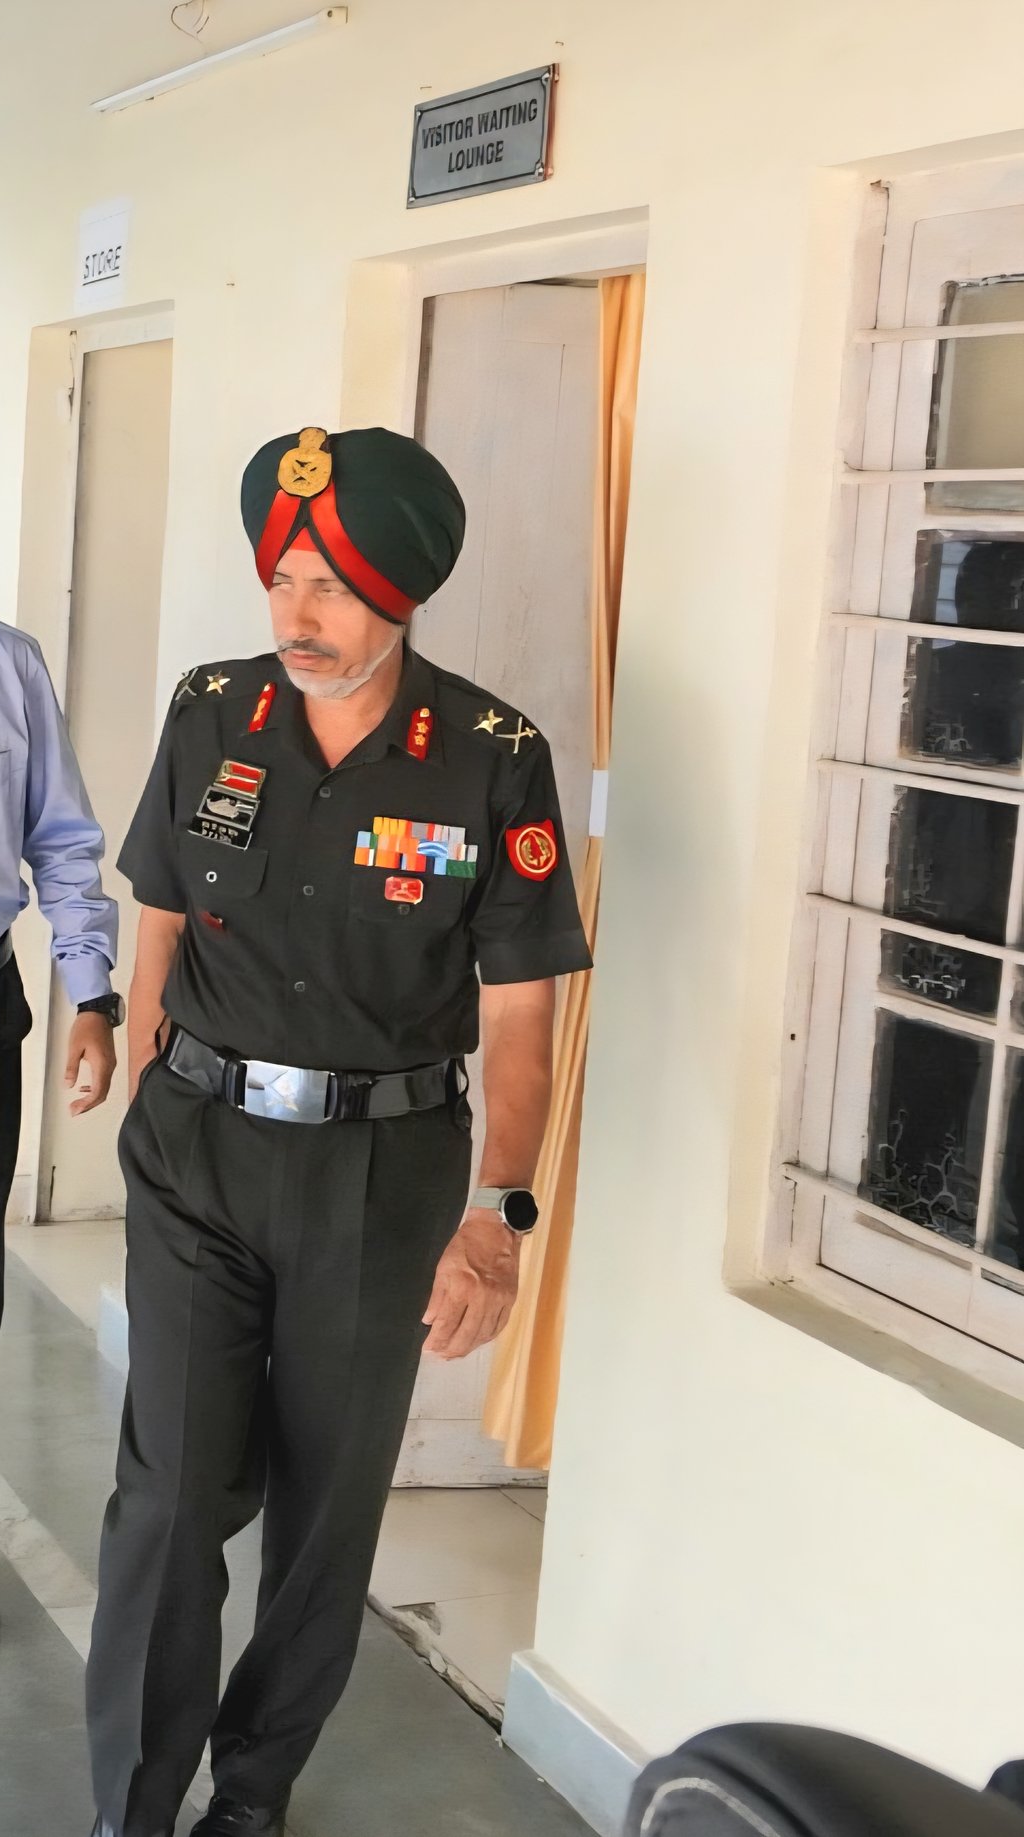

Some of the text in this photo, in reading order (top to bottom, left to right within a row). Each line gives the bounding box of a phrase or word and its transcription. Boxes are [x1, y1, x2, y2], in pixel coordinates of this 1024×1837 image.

[422, 98, 538, 149] VISITOR WAITING
[447, 140, 504, 173] LOUNGE
[83, 245, 122, 279] STORE
